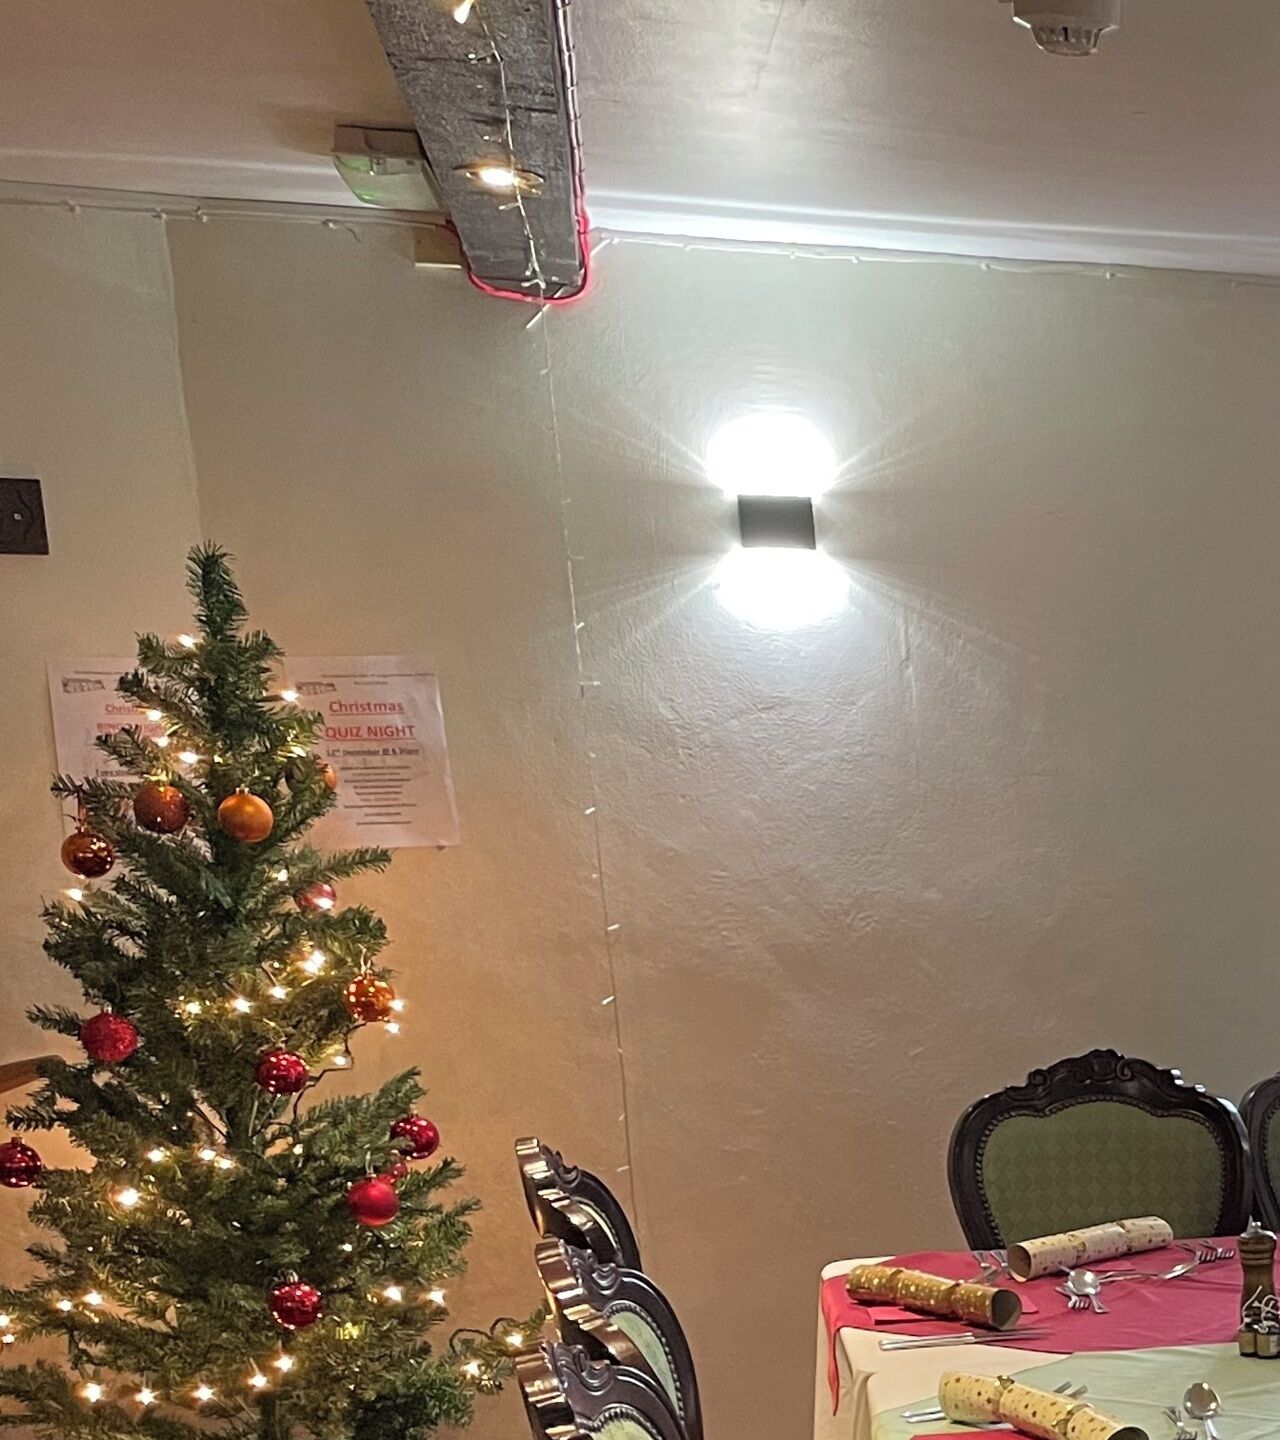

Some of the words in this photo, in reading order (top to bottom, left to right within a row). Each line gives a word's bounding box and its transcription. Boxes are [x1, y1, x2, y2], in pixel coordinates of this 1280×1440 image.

[329, 701, 404, 713] Christmas
[325, 726, 362, 738] QUIZ
[367, 725, 415, 737] NIGHT
